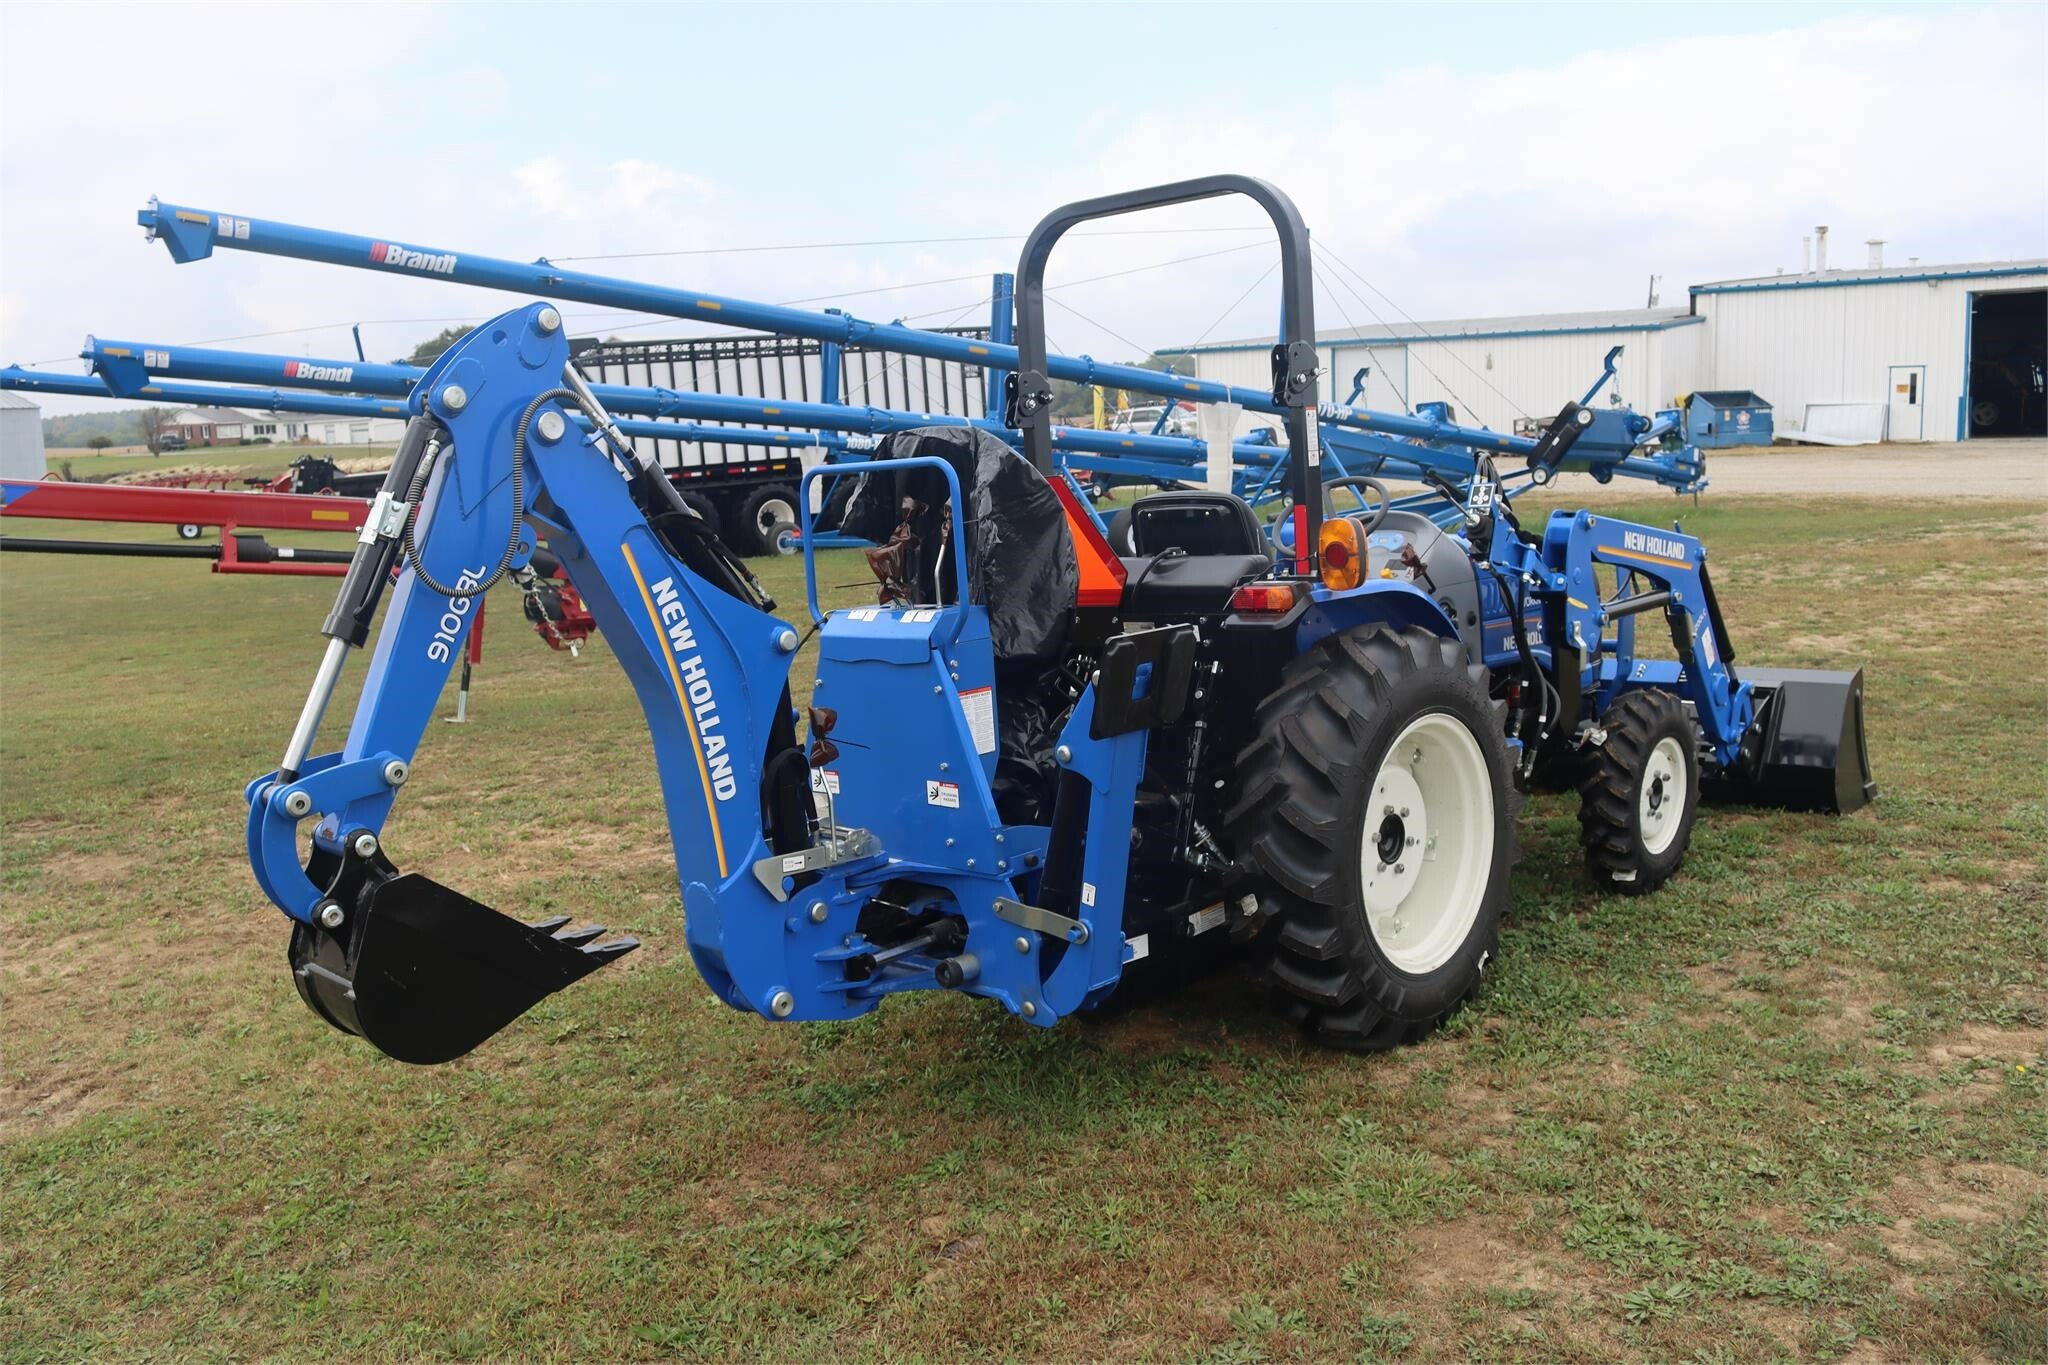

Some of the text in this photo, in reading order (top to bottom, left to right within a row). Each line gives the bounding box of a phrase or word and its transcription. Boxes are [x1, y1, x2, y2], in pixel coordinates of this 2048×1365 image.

[384, 244, 457, 274] Brandt
[295, 362, 353, 383] Brandt
[1624, 530, 1685, 560] NEW HOLLAND
[427, 565, 487, 663] 910GBL
[1503, 635, 1518, 651] NE
[651, 576, 737, 801] NEW HOLLAND
